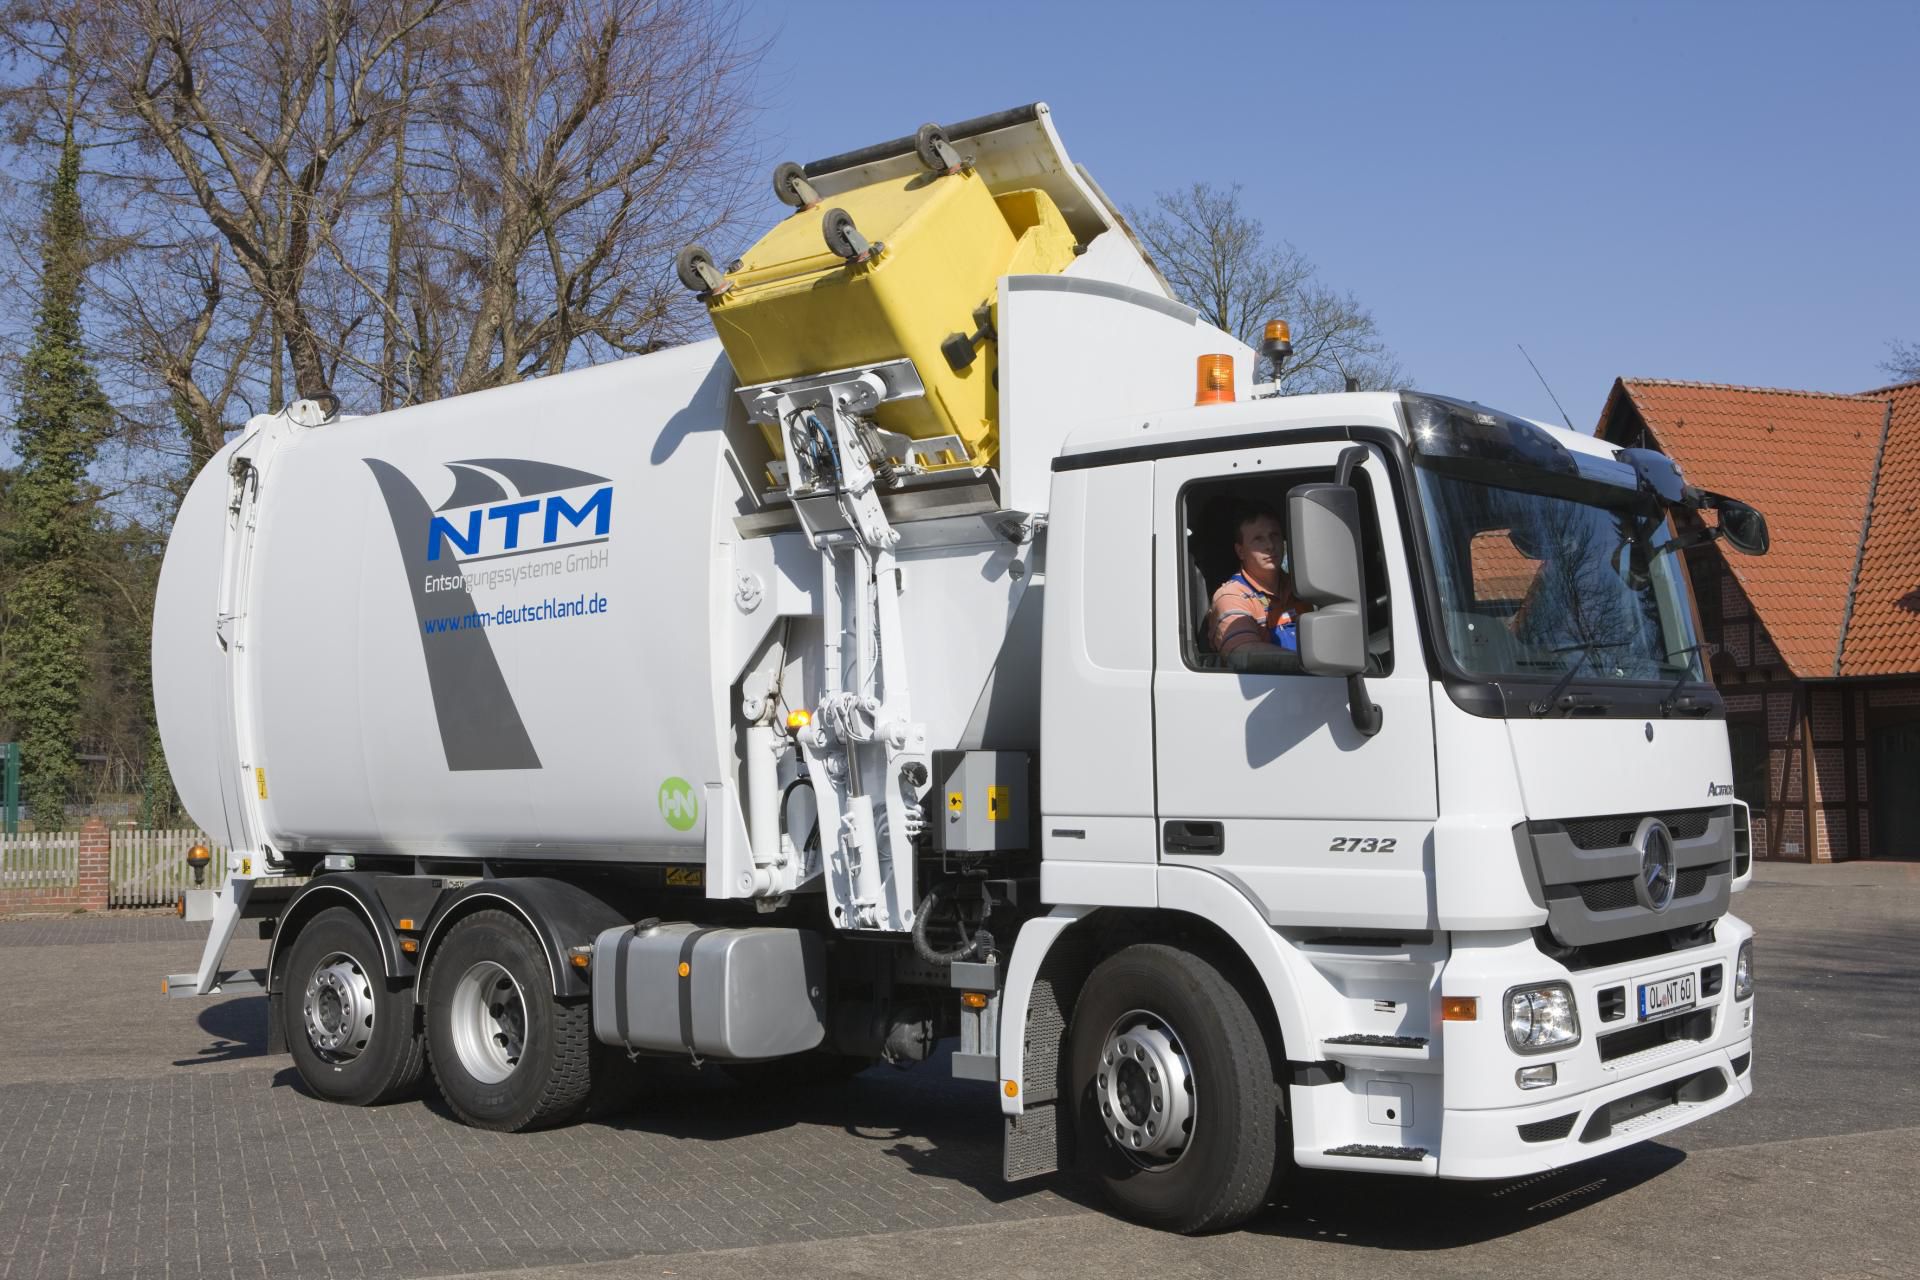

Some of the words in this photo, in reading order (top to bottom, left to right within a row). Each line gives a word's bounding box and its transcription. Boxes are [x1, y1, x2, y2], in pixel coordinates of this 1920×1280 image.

[427, 486, 613, 561] NTM
[425, 560, 562, 594] Entsorgungssysteme
[566, 549, 609, 573] GmbH
[425, 592, 607, 634] www.ntm-deutschland.de
[1328, 836, 1397, 853] 2732
[1650, 986, 1661, 1009] OL
[1667, 981, 1678, 1005] NT
[1681, 978, 1691, 1000] 60
